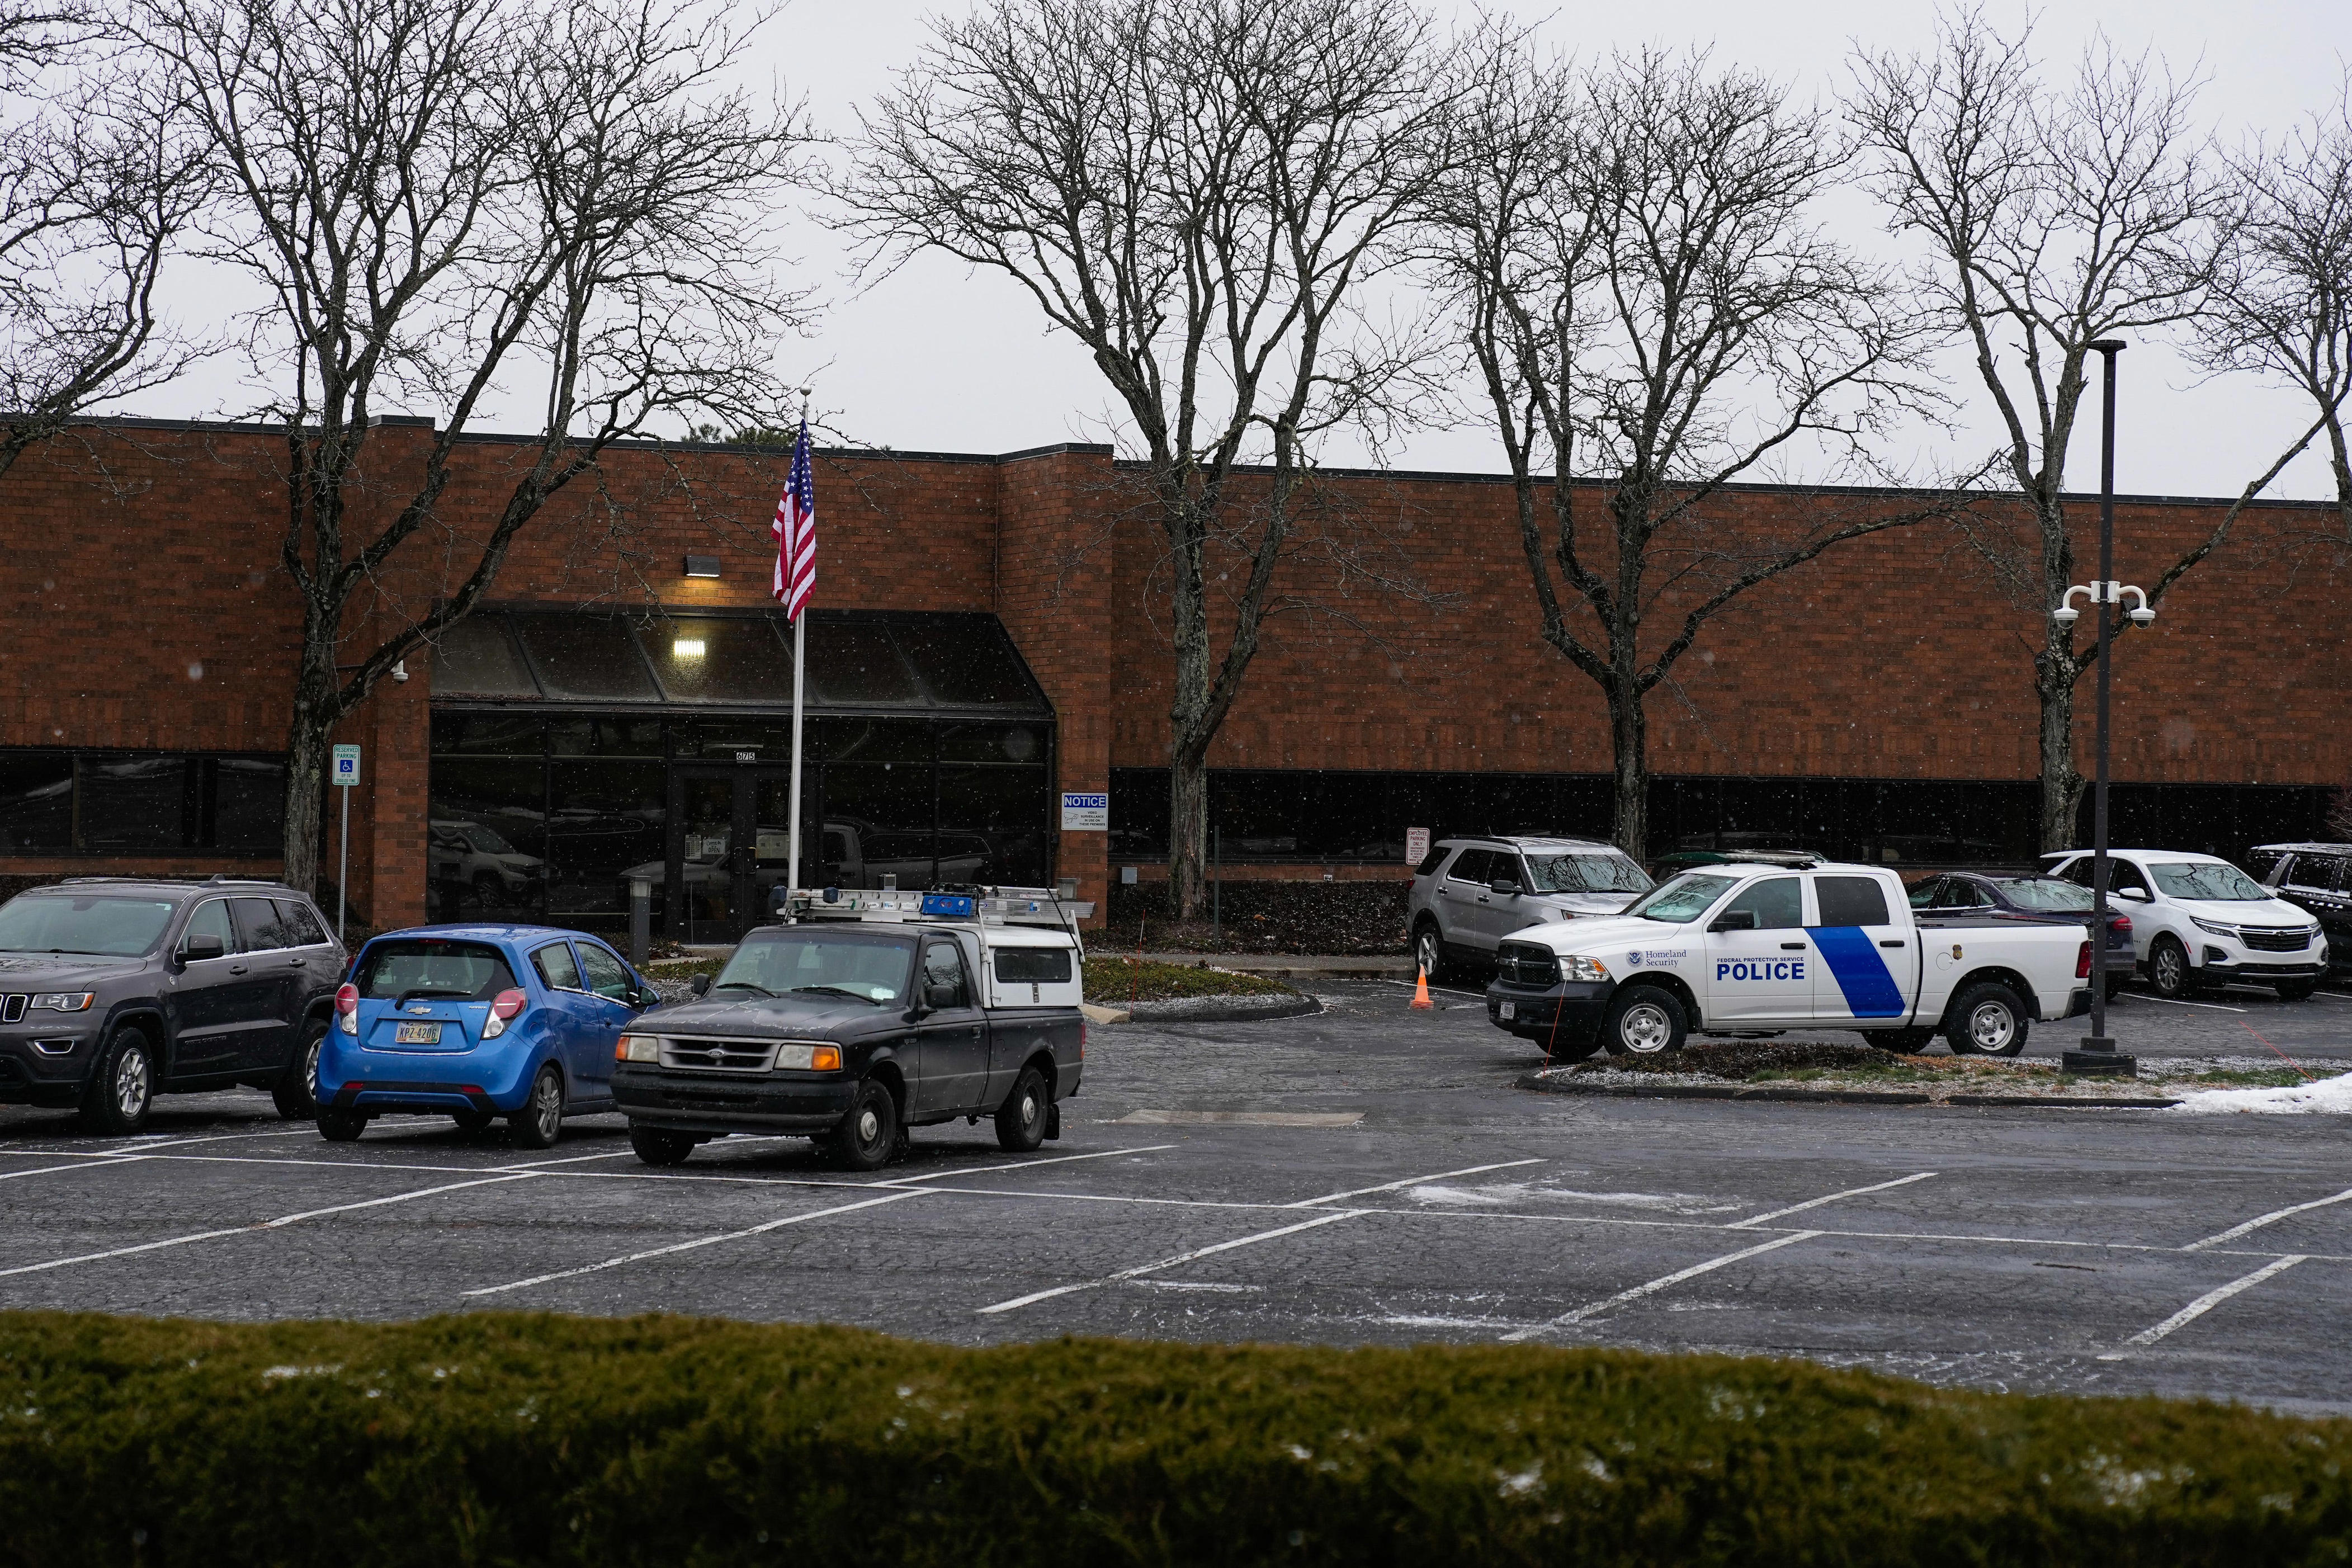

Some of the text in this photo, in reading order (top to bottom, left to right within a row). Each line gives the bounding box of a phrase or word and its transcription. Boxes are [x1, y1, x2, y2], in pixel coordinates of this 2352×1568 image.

[1065, 797, 1106, 806] NOTICE
[1646, 950, 1687, 958] Homeland
[1646, 958, 1679, 968] Security
[1717, 963, 1805, 980] POLICE
[400, 1028, 437, 1039] KPZ 4206
